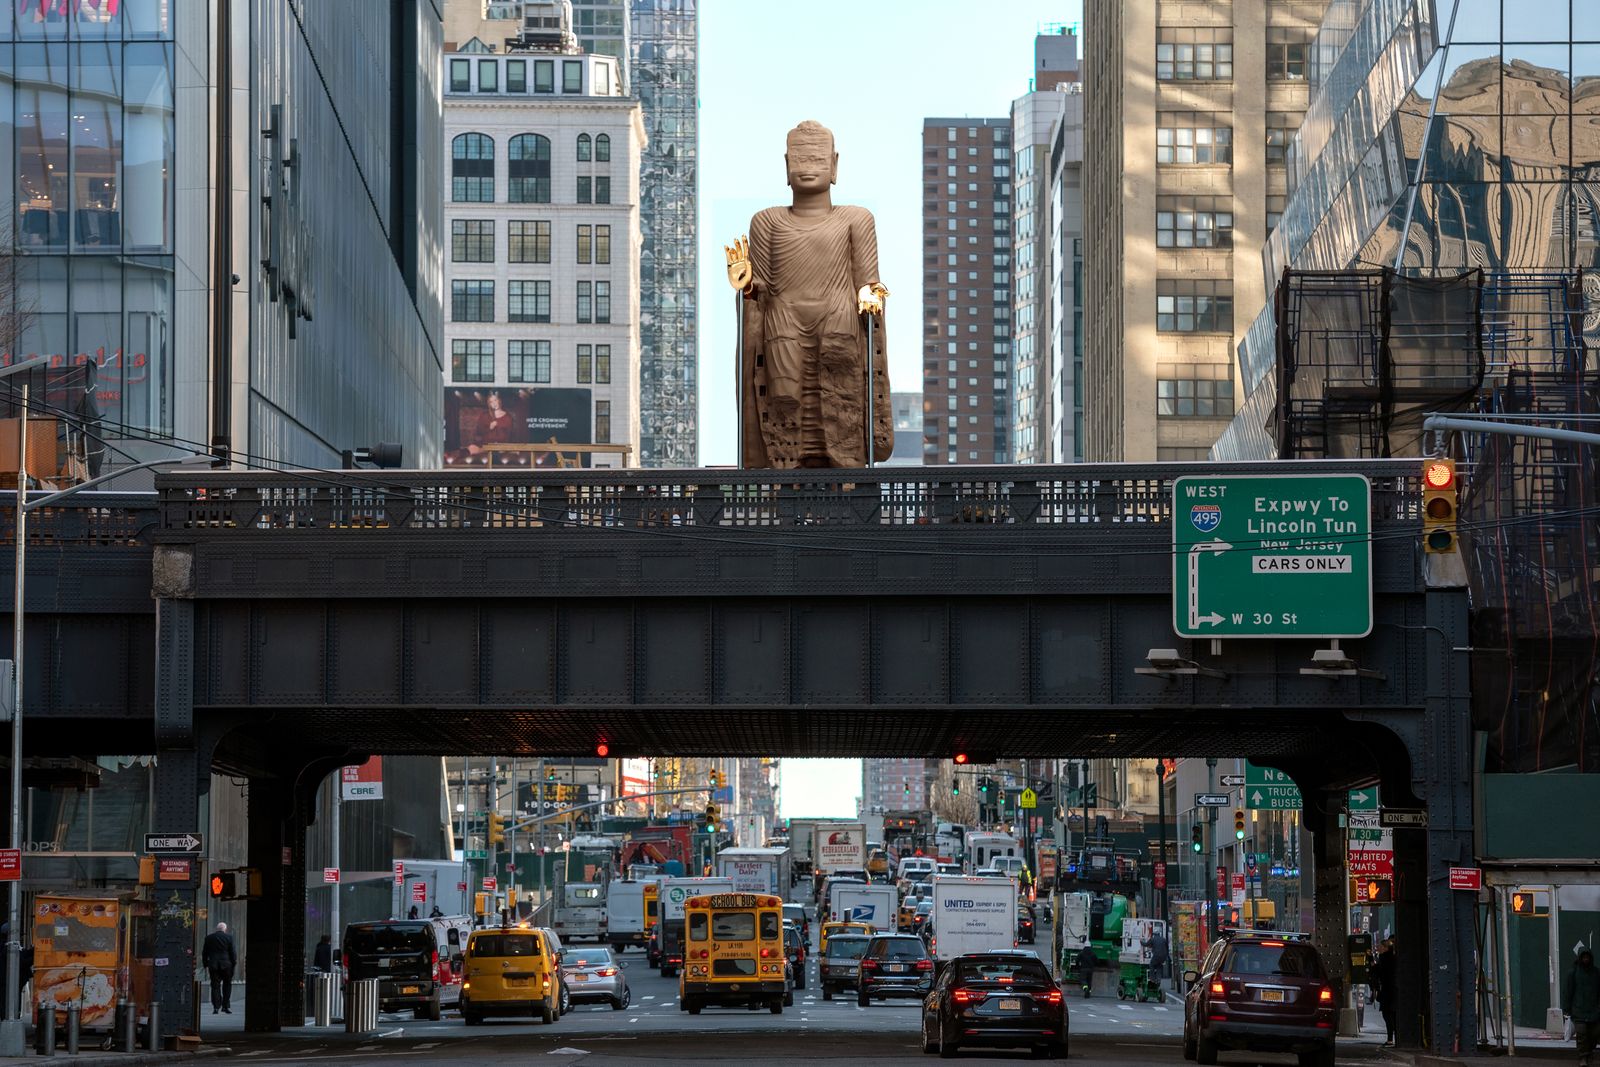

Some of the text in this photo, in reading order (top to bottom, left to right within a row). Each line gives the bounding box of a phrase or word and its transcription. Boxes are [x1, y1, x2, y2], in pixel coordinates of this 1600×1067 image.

[1186, 486, 1226, 498] WEST
[1255, 497, 1349, 515] Expwy To
[1193, 513, 1219, 525] 495
[1247, 519, 1357, 534] Lincoln Tun
[1260, 539, 1343, 552] New Jersey
[1258, 558, 1346, 570] CARS ONLY
[1232, 613, 1297, 624] W 30 St
[350, 787, 375, 795] CBRE
[1267, 787, 1301, 797] TRUCK
[1271, 799, 1303, 808] BUSES
[1388, 814, 1428, 822] ONE WAY
[1350, 829, 1357, 839] W
[1360, 829, 1371, 840] 30
[153, 839, 194, 847] ONE WAY
[1349, 853, 1388, 861] OHIBITED
[1349, 863, 1377, 871] ZMATS
[711, 895, 755, 907] SCHOOL BUS
[944, 899, 974, 909] UNITED
